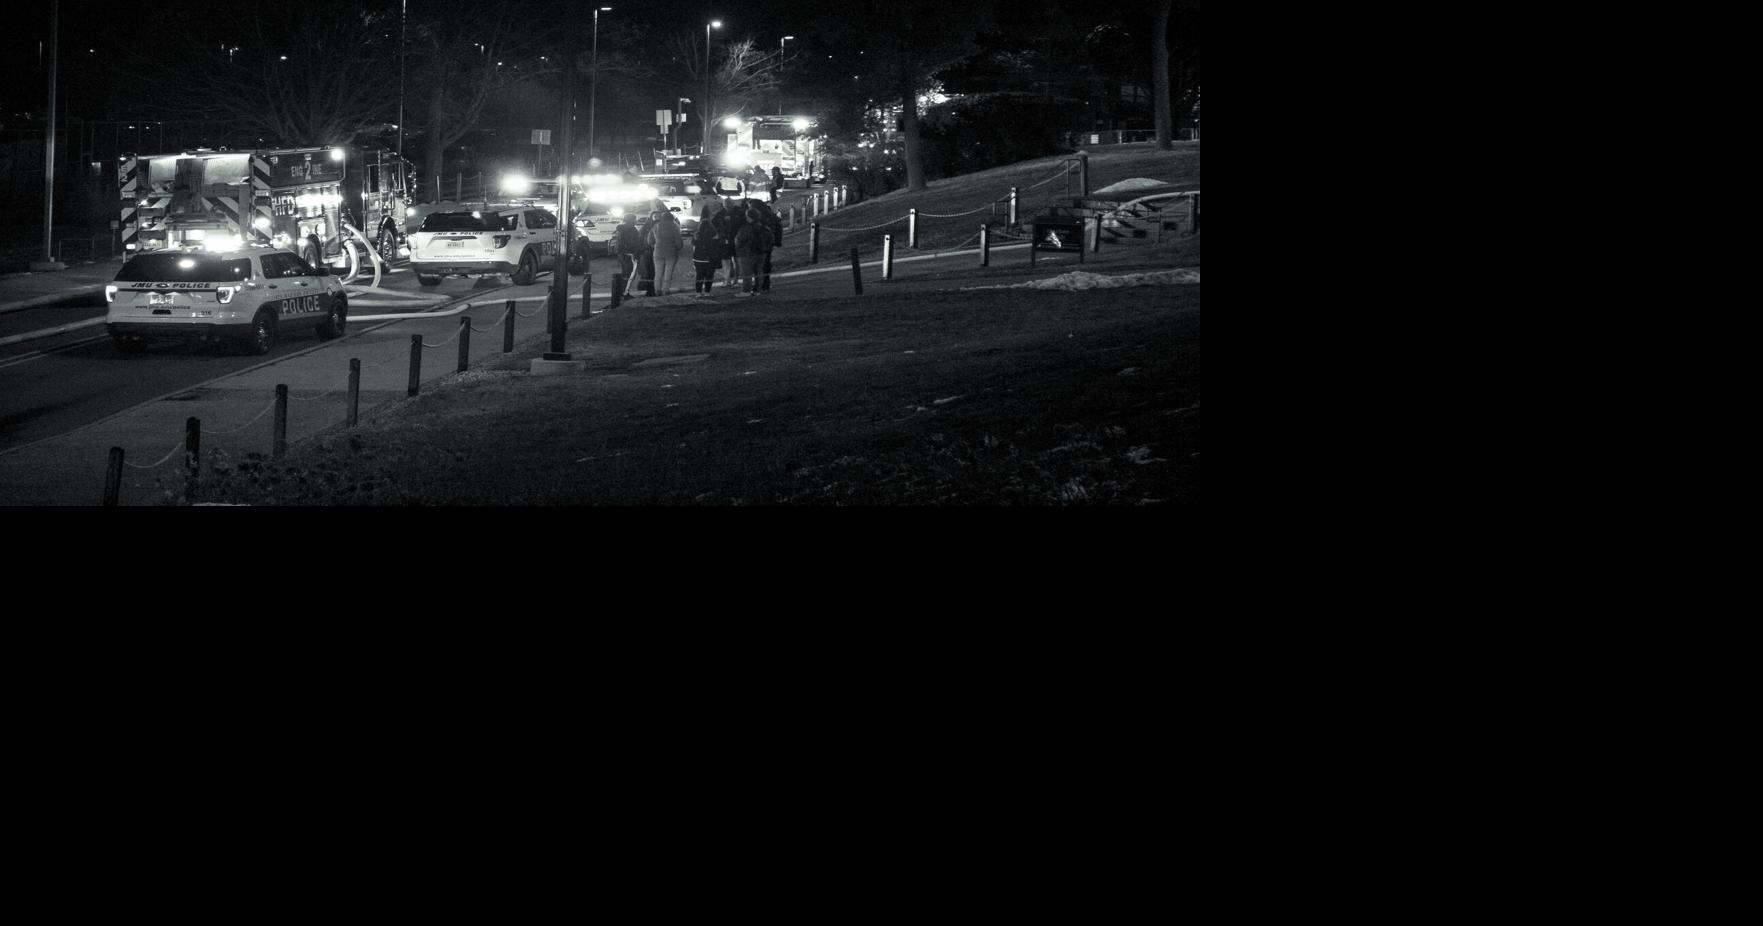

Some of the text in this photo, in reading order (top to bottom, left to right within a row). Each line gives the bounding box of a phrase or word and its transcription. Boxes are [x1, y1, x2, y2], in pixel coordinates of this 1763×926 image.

[291, 165, 304, 177] ENG
[304, 161, 312, 180] 2
[274, 195, 296, 216] HFD
[281, 295, 321, 315] POLICE
